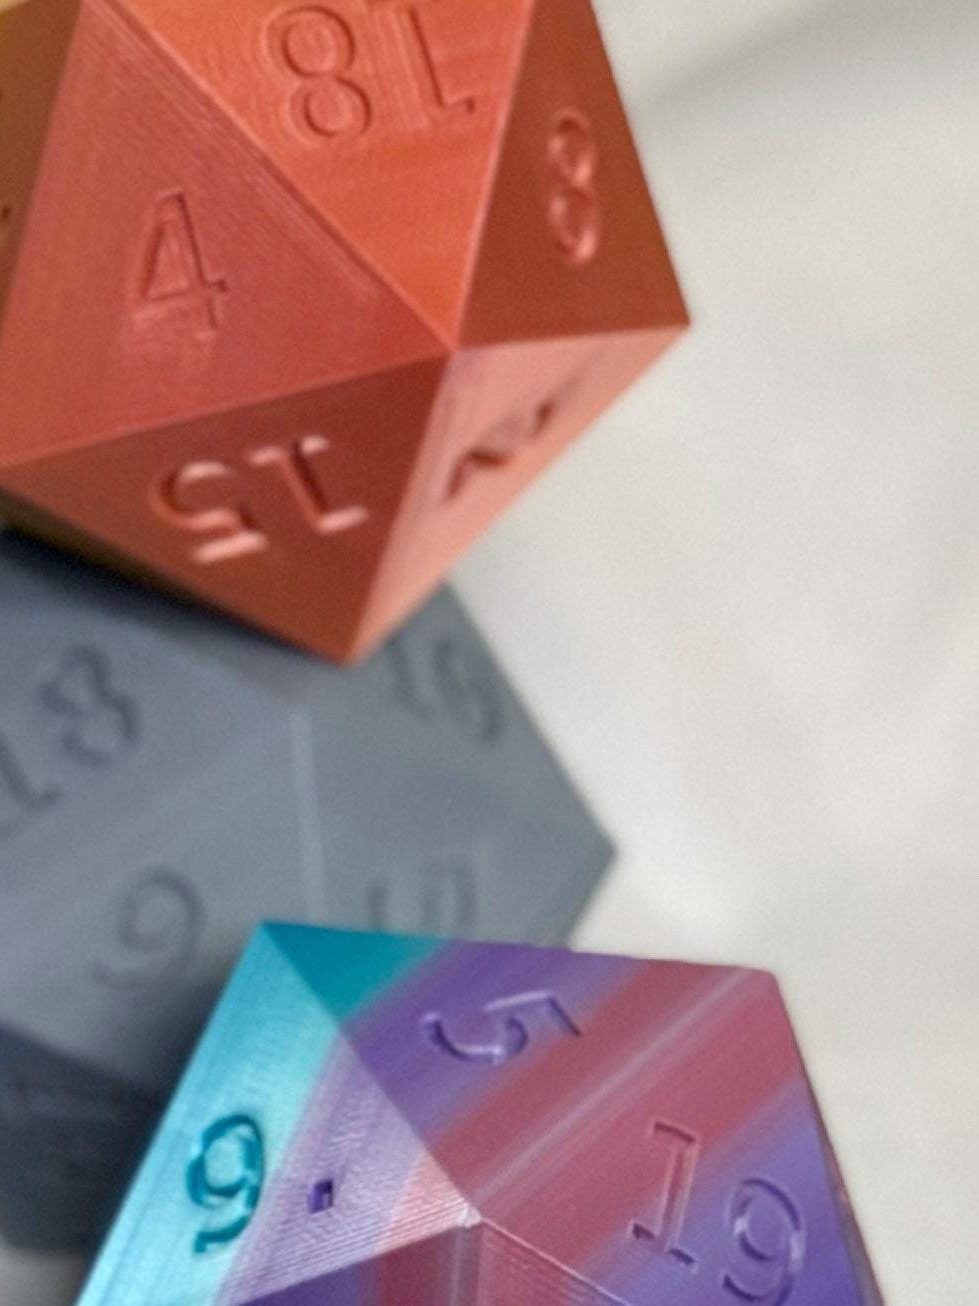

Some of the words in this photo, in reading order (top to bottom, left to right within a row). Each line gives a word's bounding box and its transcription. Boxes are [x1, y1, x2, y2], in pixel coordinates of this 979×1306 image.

[262, 2, 477, 146] 18
[546, 106, 602, 267] 8
[134, 190, 228, 338] 4
[149, 434, 370, 564] 15
[90, 866, 204, 992] 9
[425, 990, 581, 1066] 5
